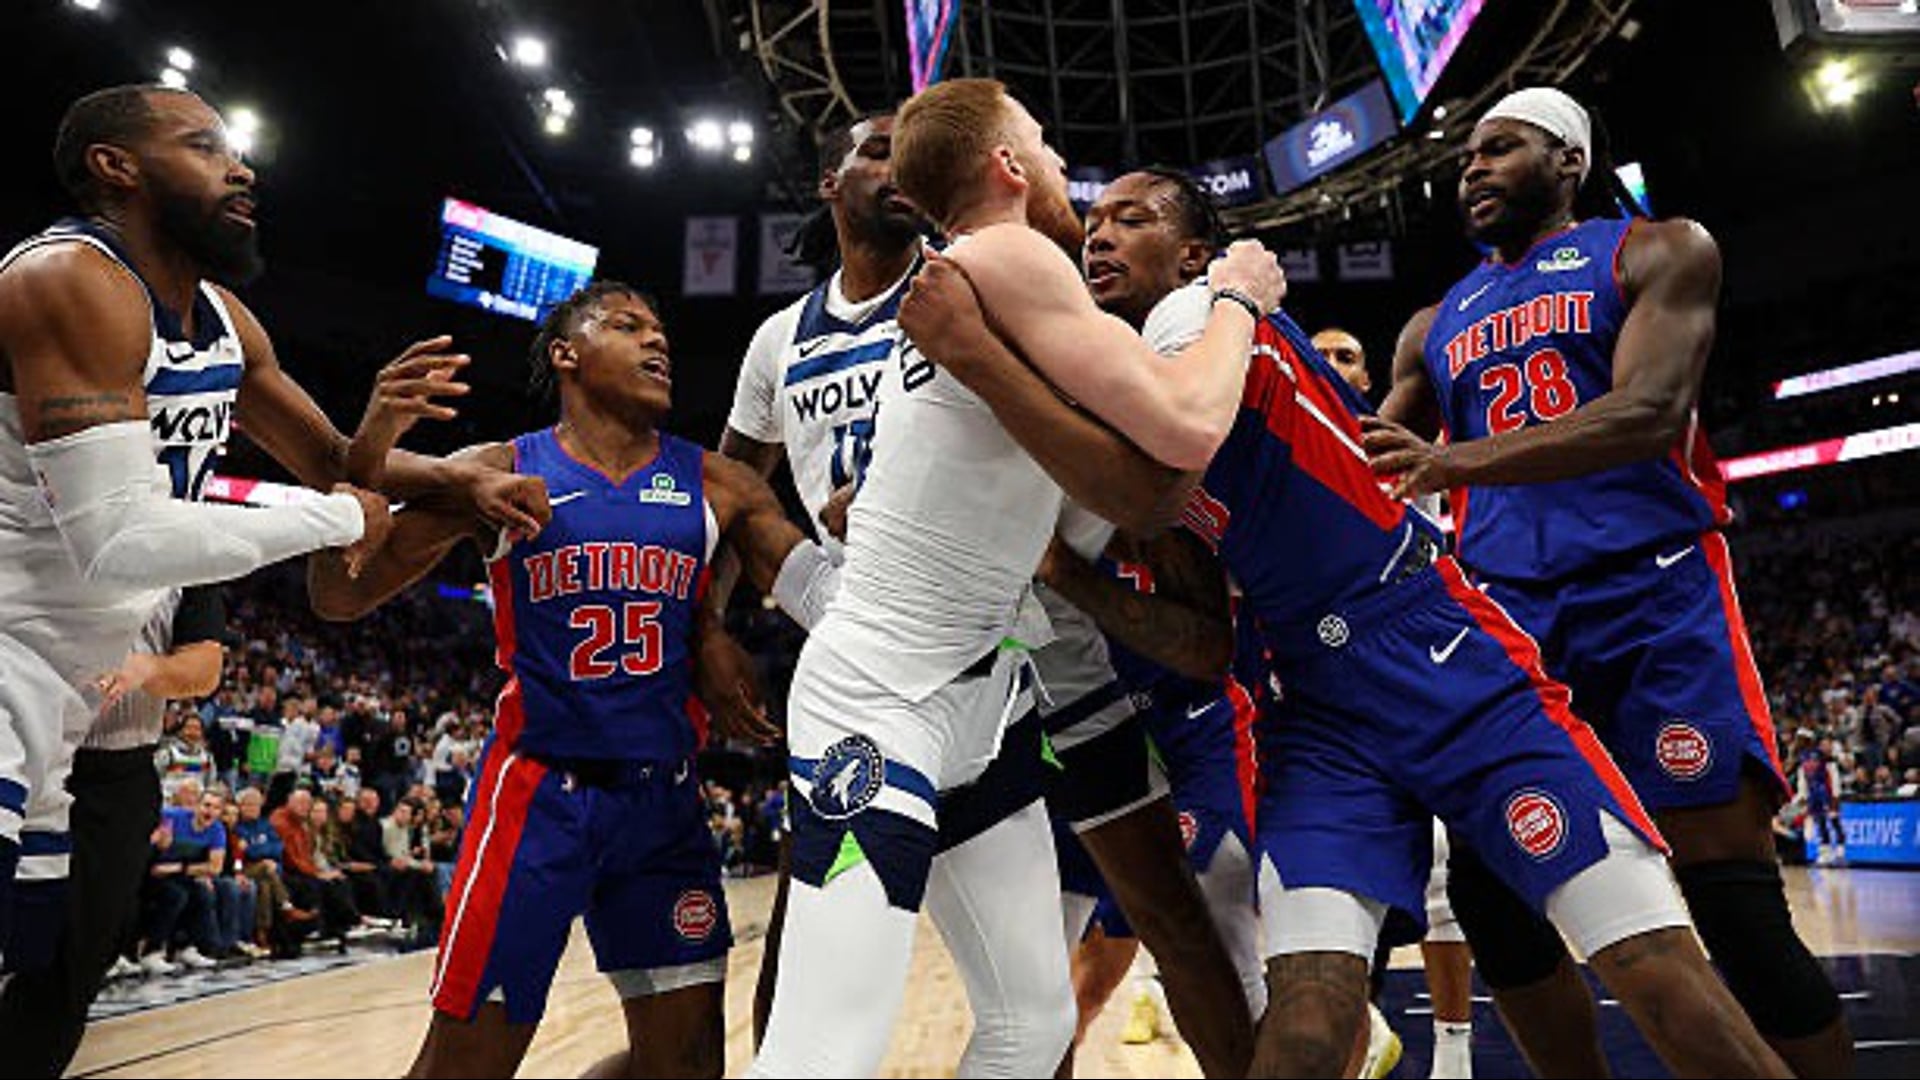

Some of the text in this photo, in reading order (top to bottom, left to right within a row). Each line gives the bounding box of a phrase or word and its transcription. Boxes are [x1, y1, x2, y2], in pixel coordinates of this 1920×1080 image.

[1445, 291, 1595, 381] DETROIT
[1480, 348, 1578, 436] 28
[523, 541, 698, 602] DETROIT
[569, 602, 663, 681] 25
